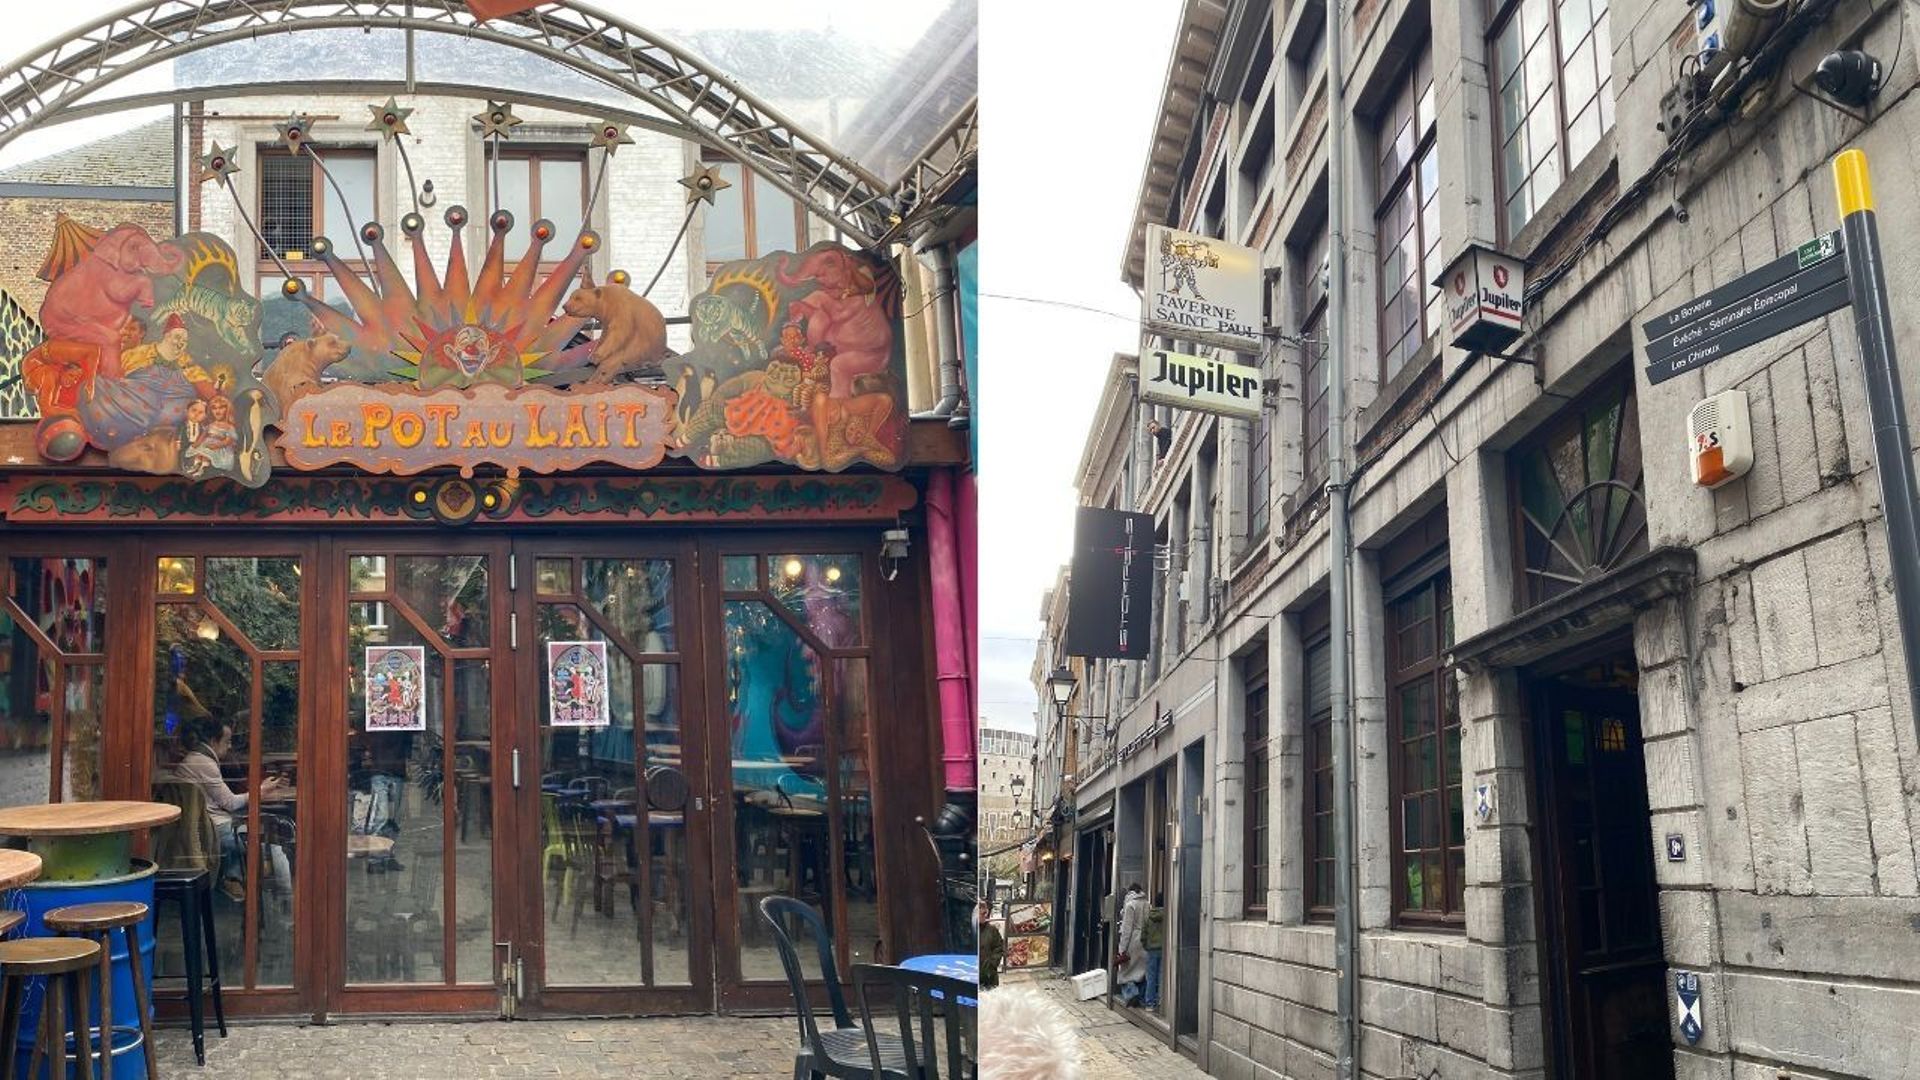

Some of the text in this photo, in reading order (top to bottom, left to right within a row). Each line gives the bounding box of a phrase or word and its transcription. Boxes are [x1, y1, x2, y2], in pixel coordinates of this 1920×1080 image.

[1156, 293, 1236, 320] TAVERNE
[1482, 288, 1522, 312] Jupiler
[1669, 299, 1713, 325] La Boverie
[1156, 308, 1257, 339] SAINT PAUL
[1709, 306, 1753, 330] Séminaire
[1671, 344, 1720, 371] Les Chiroux
[1149, 351, 1257, 399] Jupiler
[301, 411, 353, 448] LE
[361, 403, 460, 449] POT
[461, 419, 514, 449] AU
